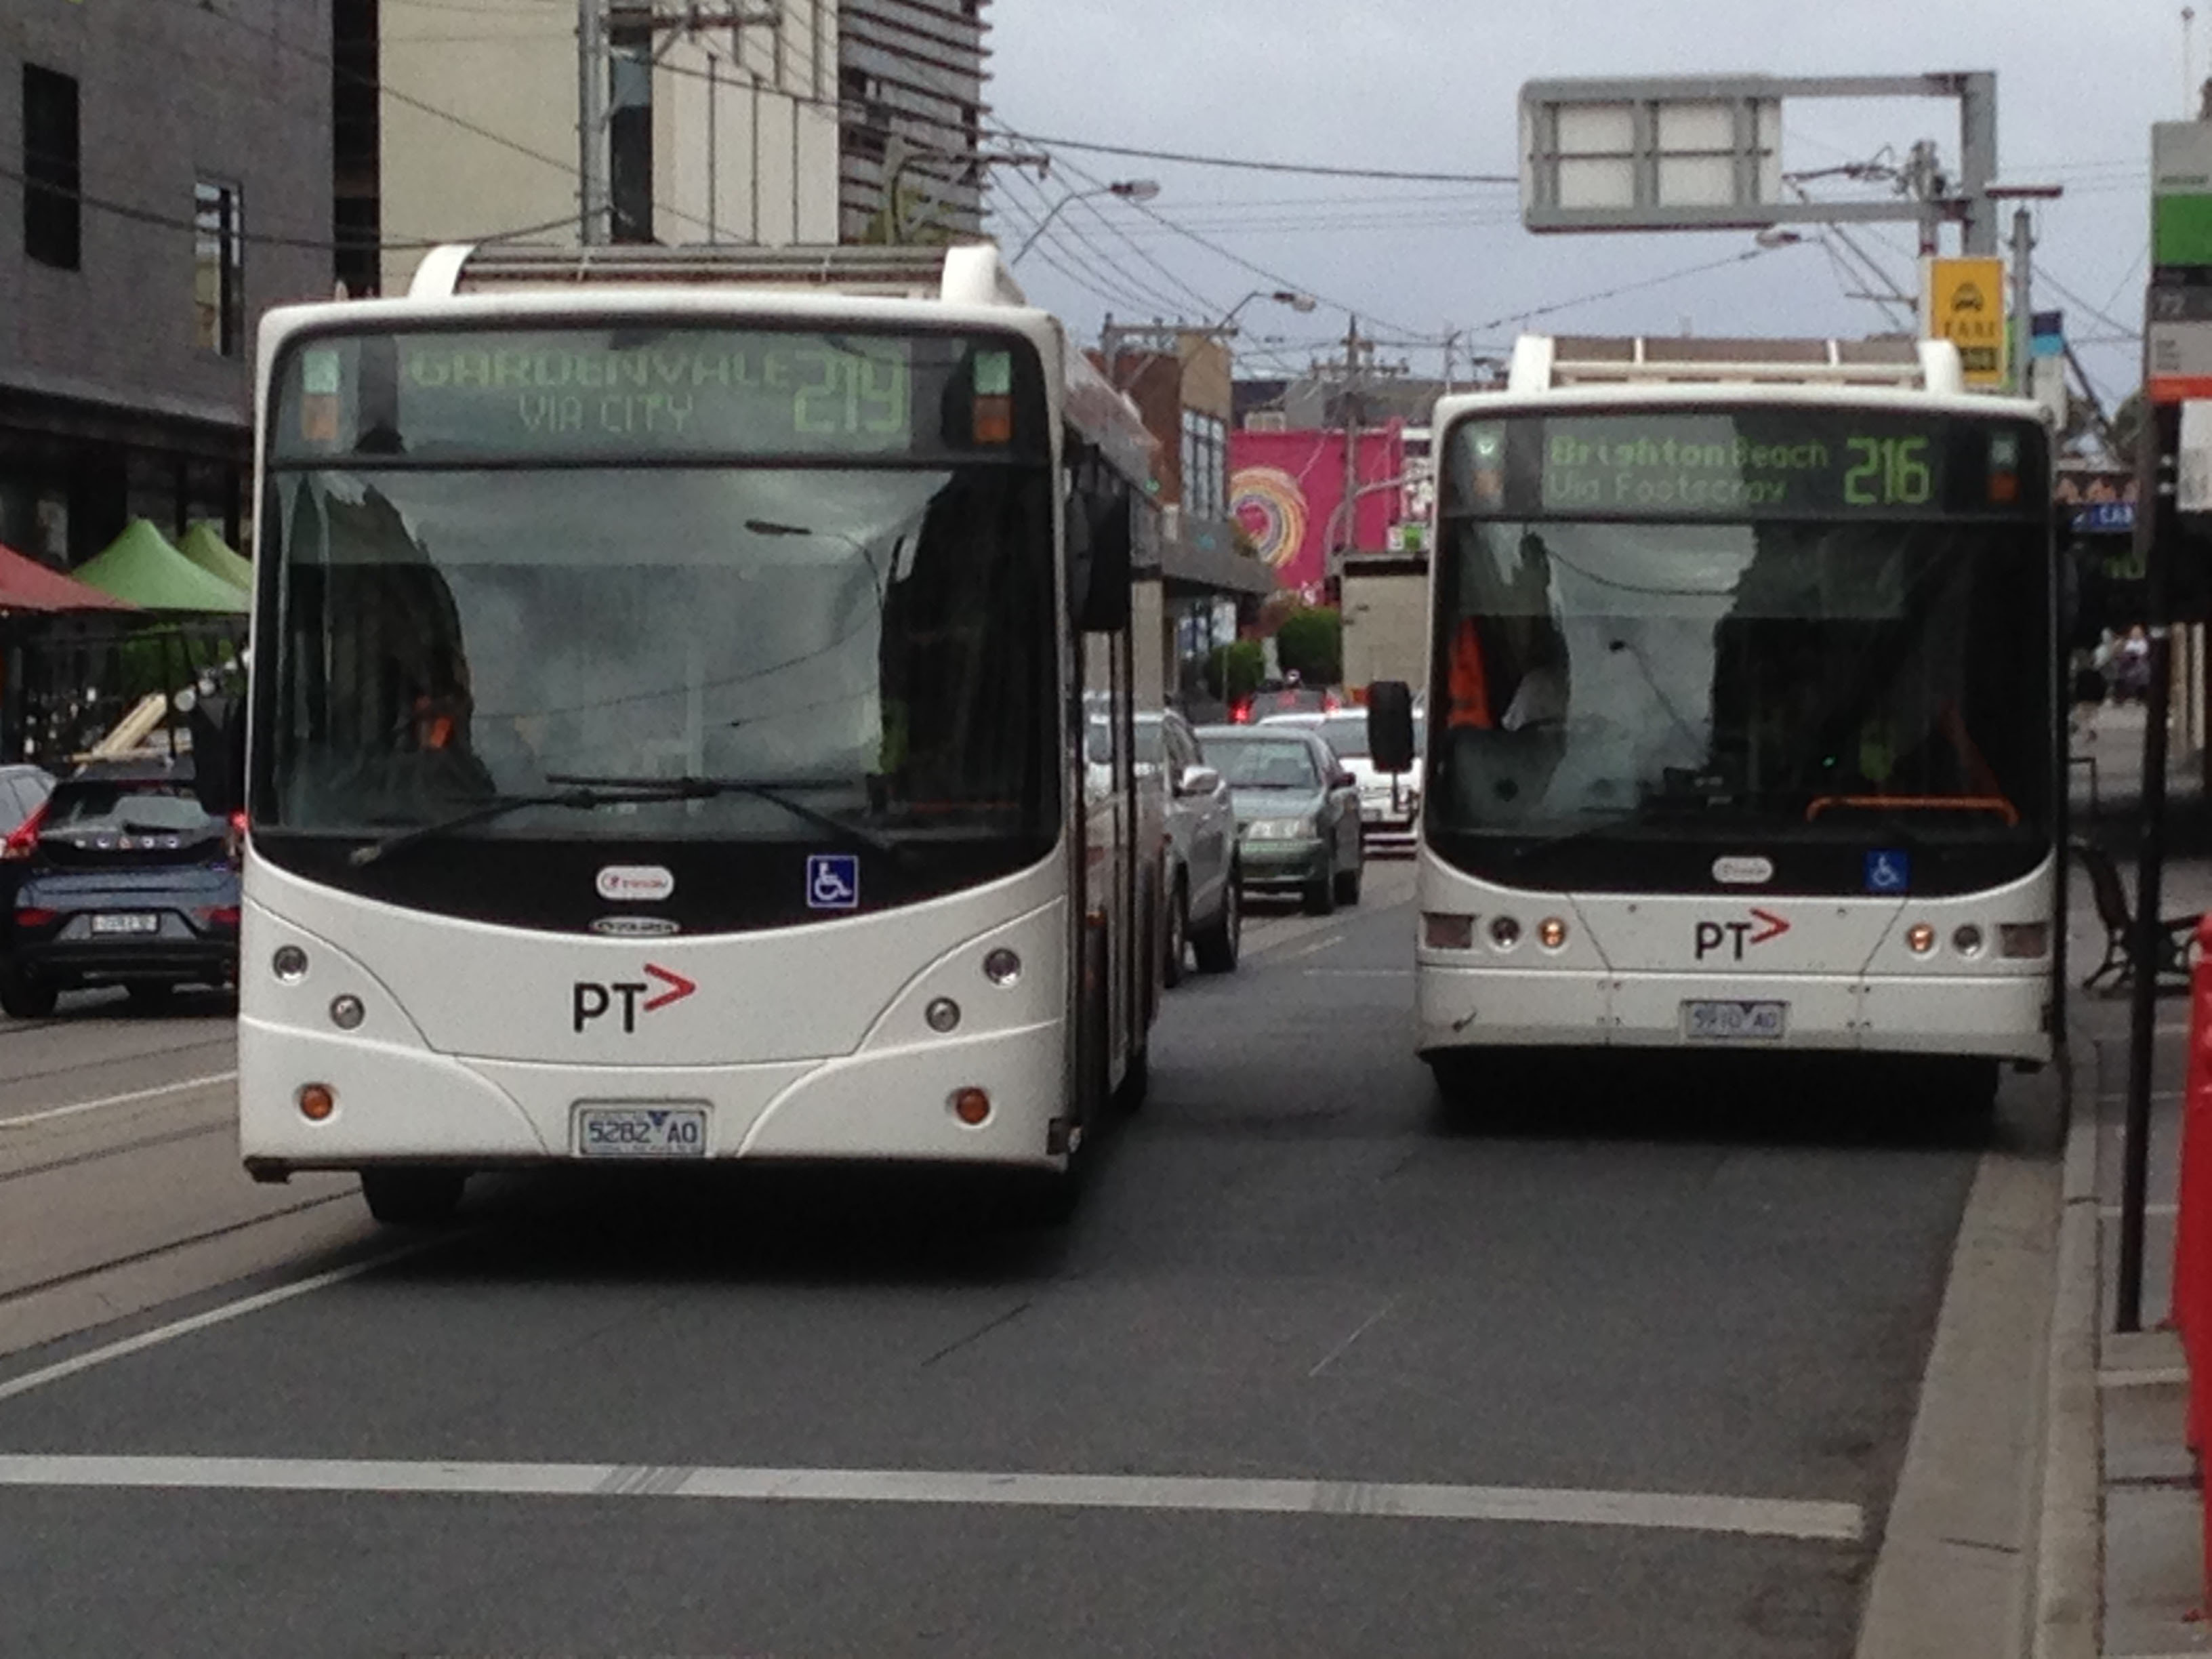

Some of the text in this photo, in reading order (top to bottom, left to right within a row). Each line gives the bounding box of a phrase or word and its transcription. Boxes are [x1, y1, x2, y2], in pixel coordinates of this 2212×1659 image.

[409, 349, 790, 387] GARDENVALE
[794, 349, 904, 432] 219
[518, 392, 693, 434] VIA CITY
[1550, 434, 1830, 468] Brighton Beach
[1550, 472, 1788, 504] Via Footscray
[1843, 436, 1931, 506] 216
[588, 1121, 651, 1144] 5282
